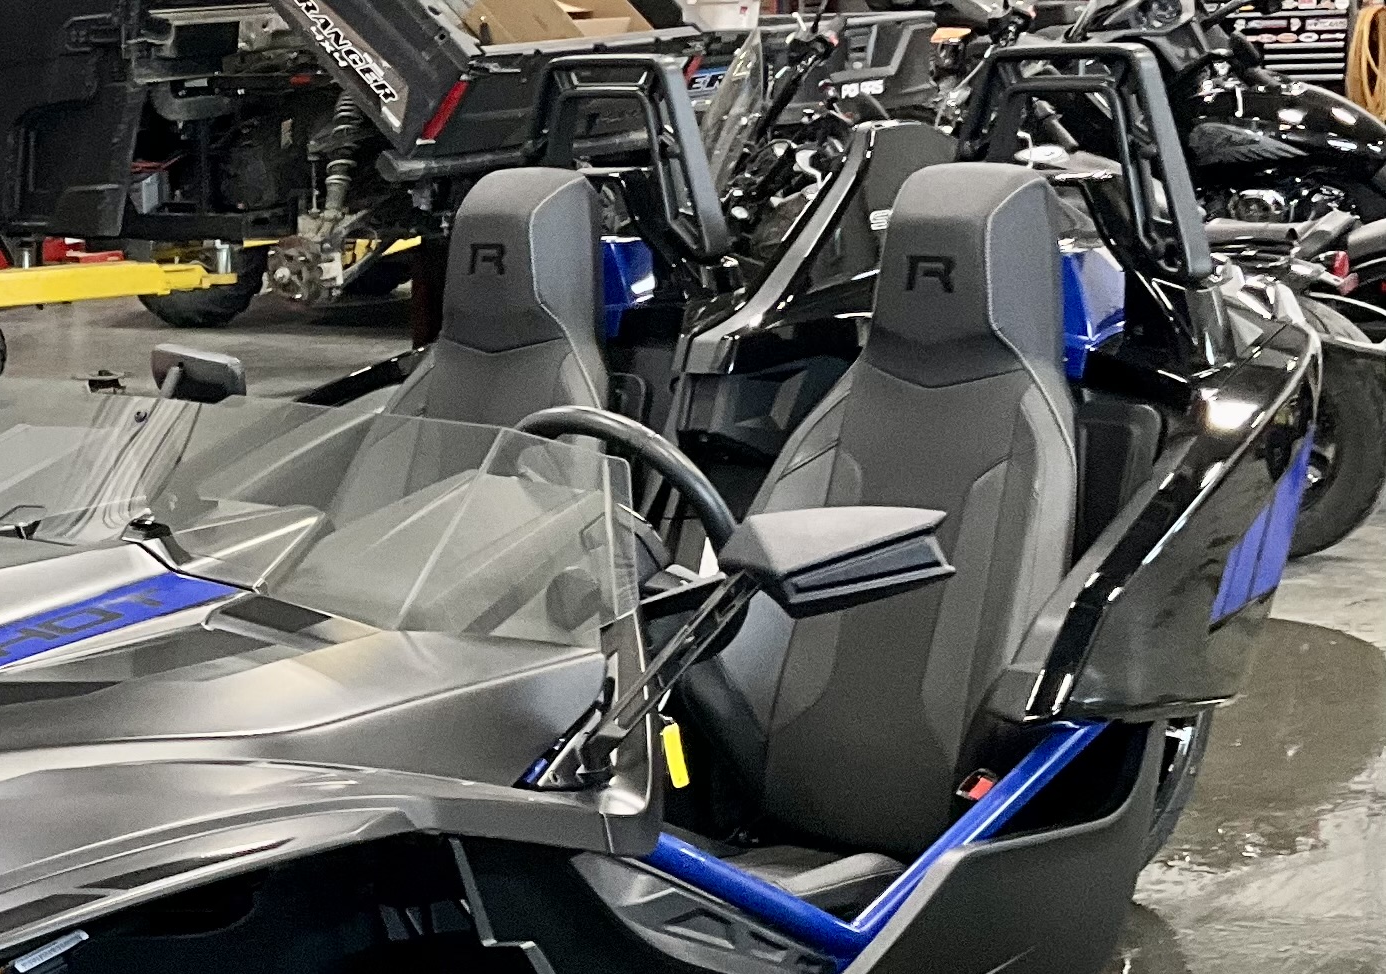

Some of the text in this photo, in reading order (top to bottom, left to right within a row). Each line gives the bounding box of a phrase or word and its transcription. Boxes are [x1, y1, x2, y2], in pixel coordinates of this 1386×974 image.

[293, 0, 399, 103] RANGER
[467, 243, 505, 275] R
[905, 255, 955, 293] R
